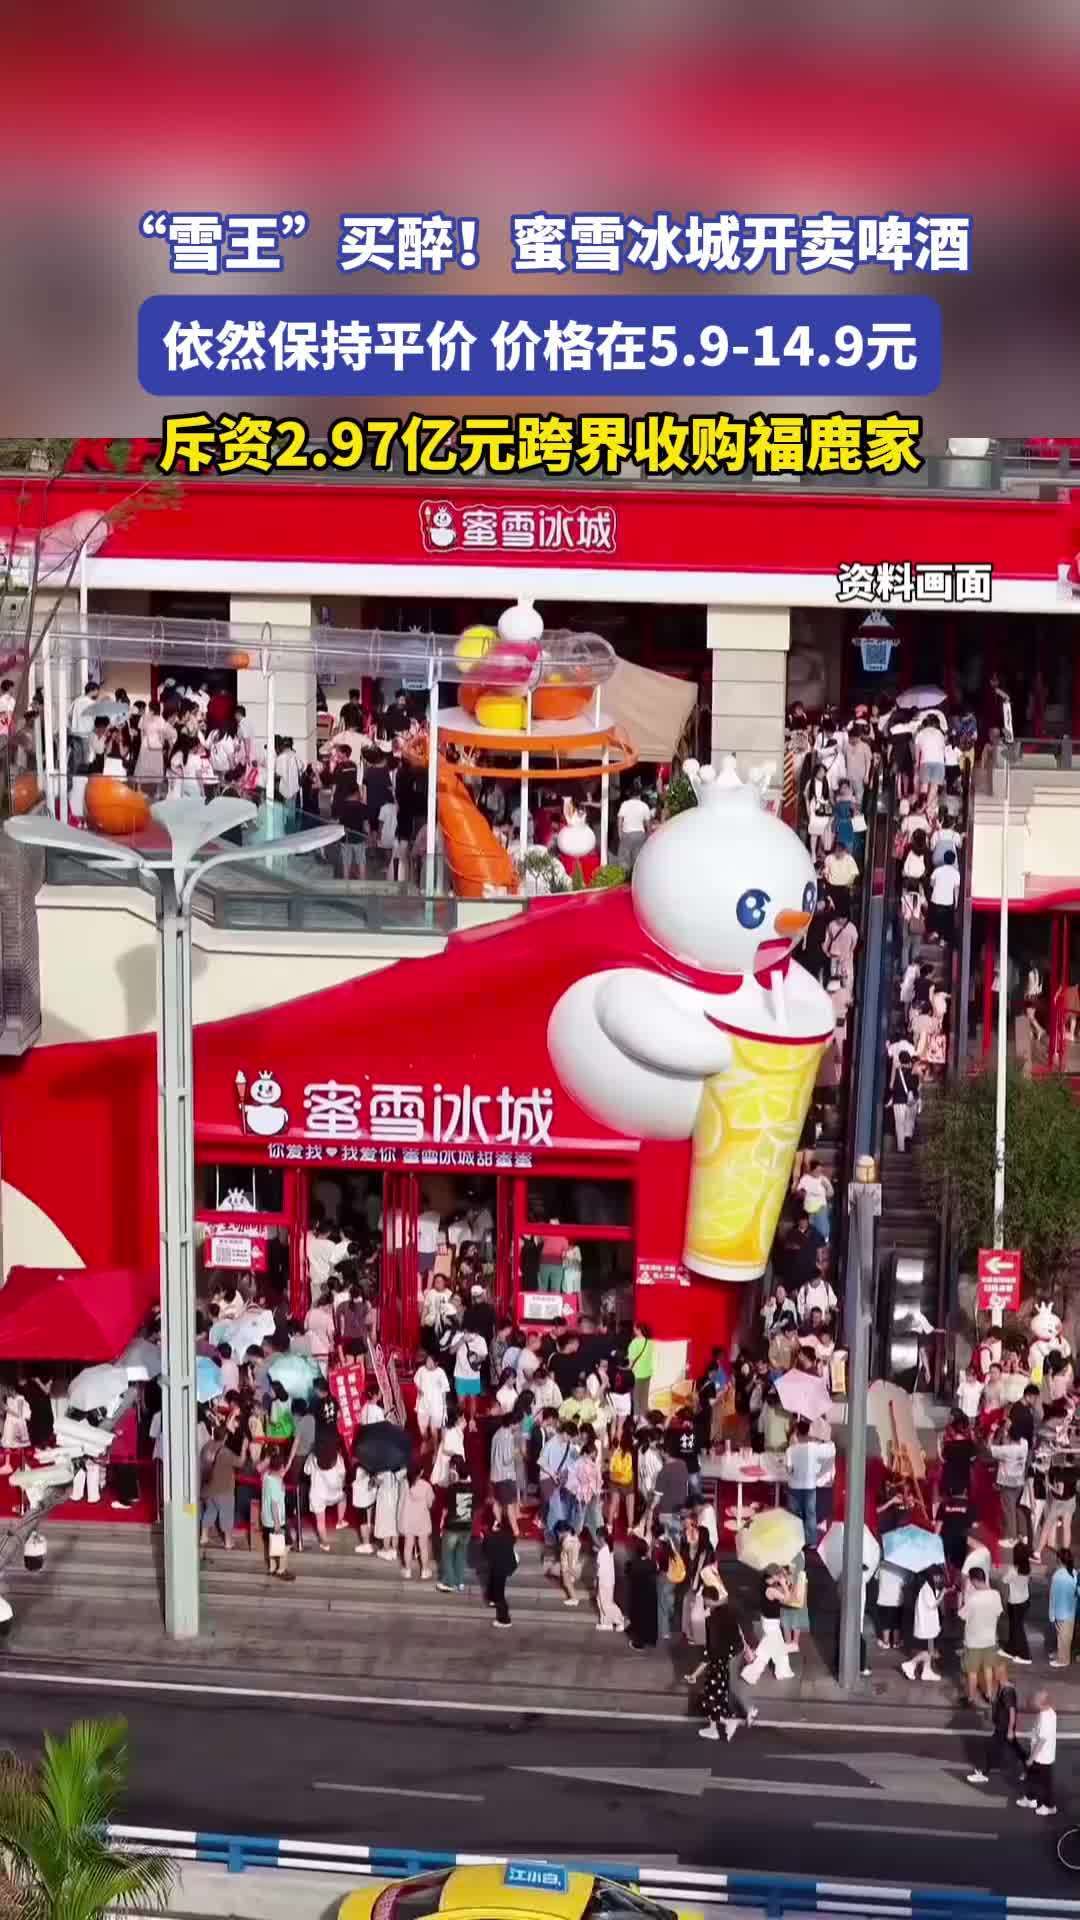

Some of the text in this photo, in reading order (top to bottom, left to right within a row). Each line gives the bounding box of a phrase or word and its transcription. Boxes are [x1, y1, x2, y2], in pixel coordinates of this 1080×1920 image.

[462, 510, 612, 549] 蜜雪冰城
[303, 1079, 554, 1147] 蜜雪冰城
